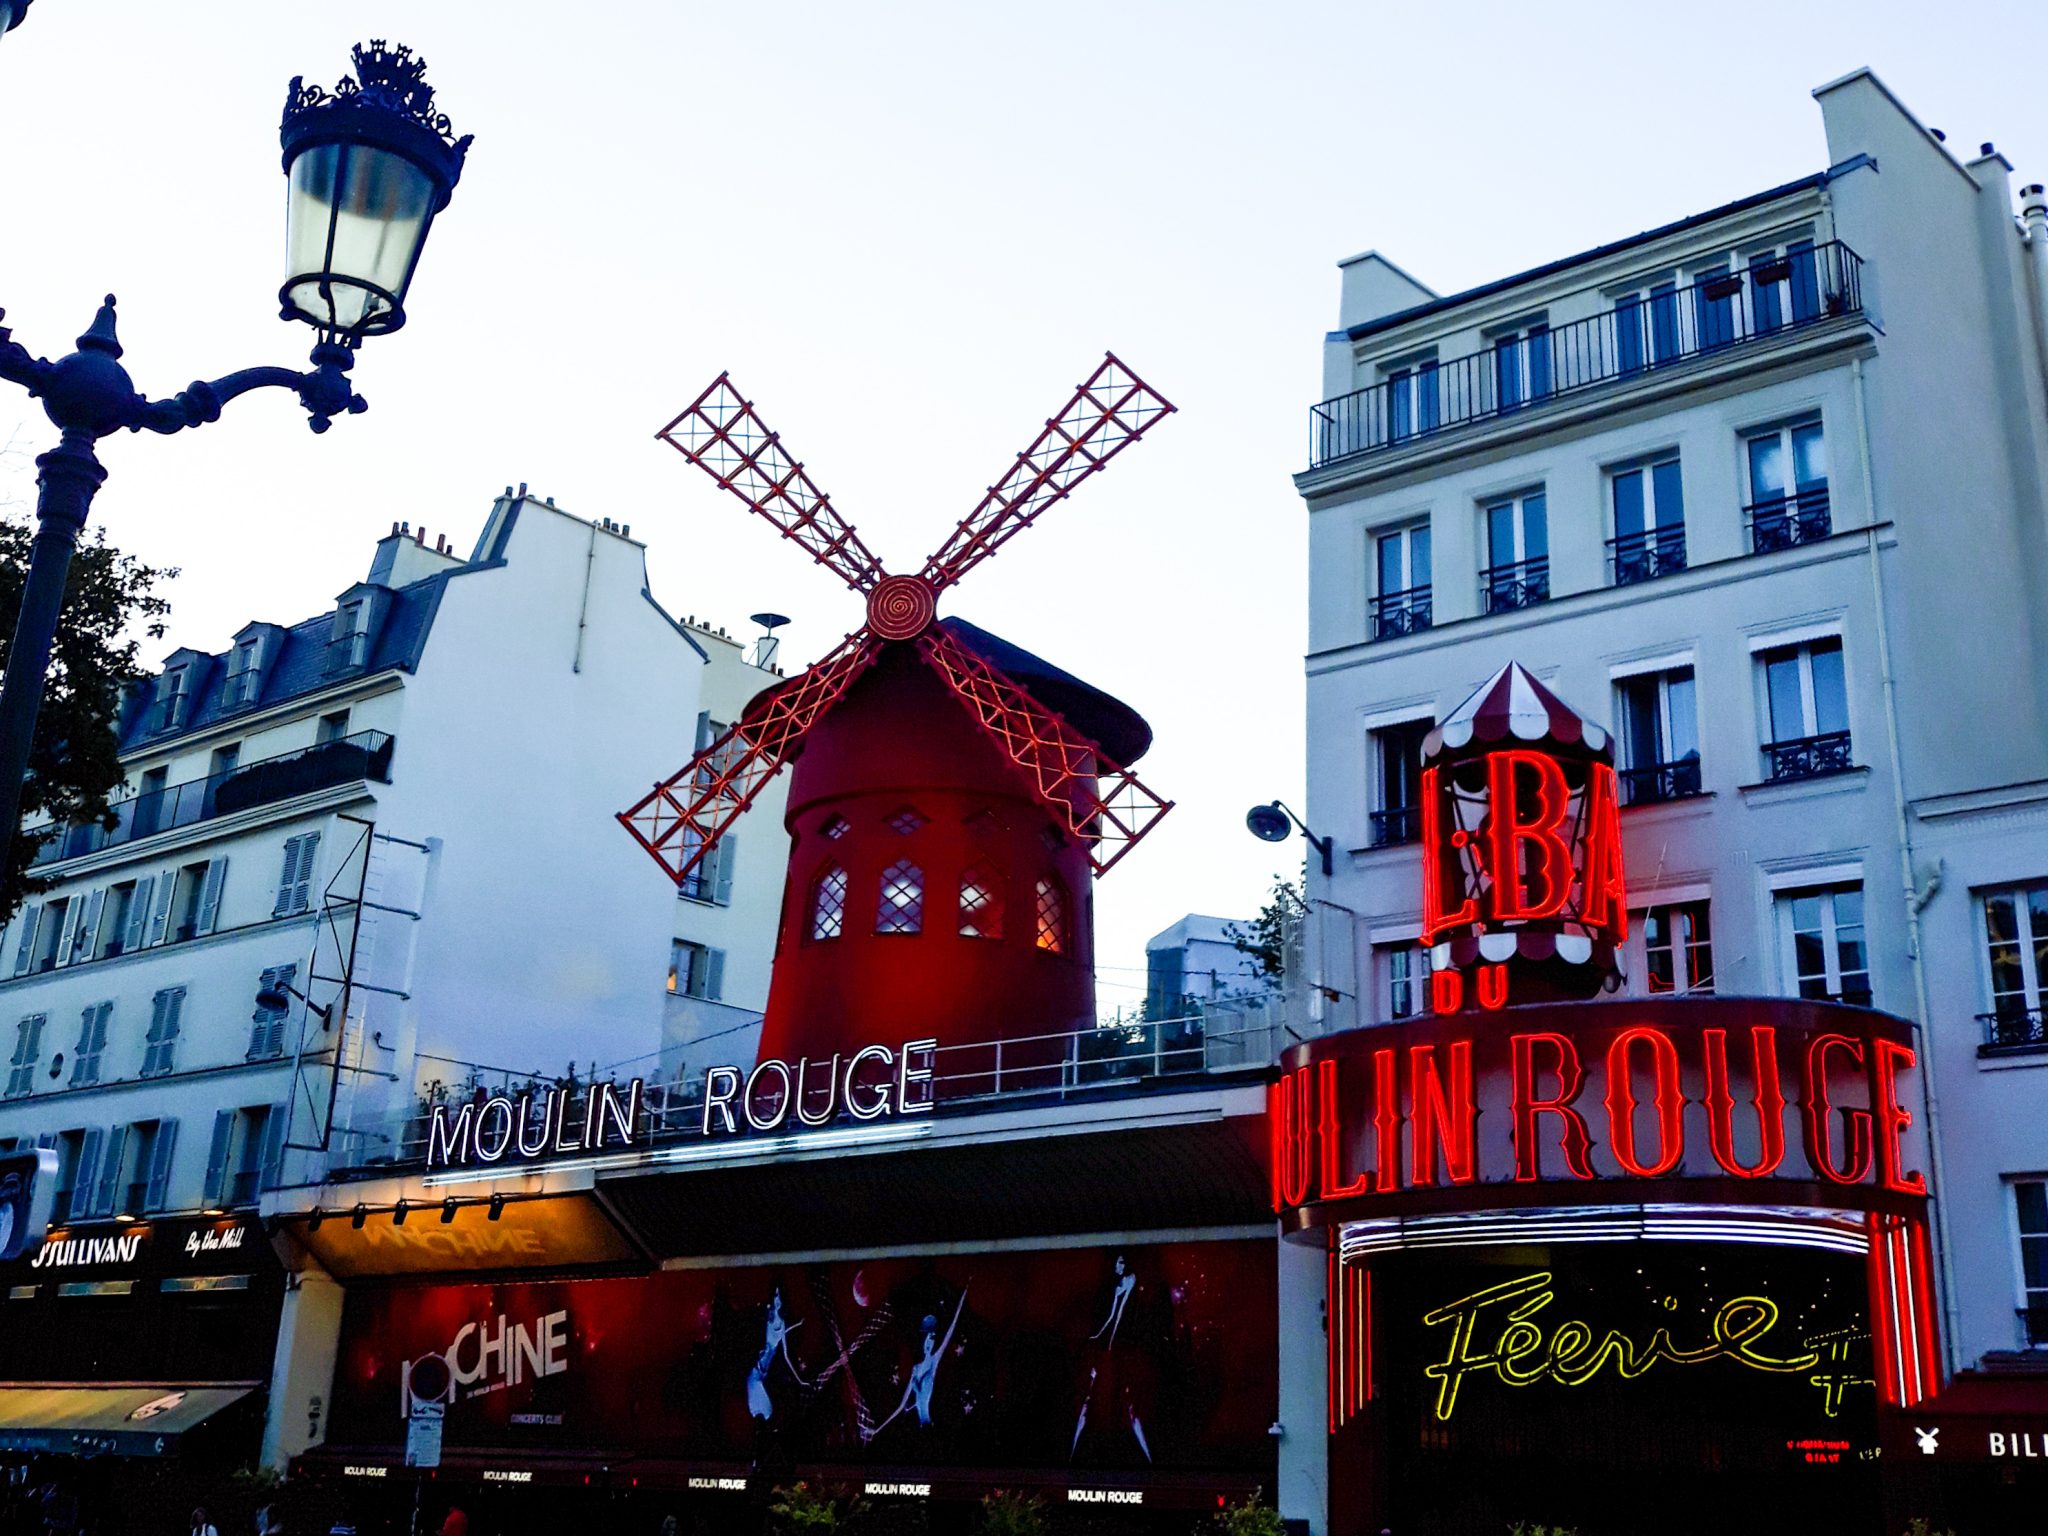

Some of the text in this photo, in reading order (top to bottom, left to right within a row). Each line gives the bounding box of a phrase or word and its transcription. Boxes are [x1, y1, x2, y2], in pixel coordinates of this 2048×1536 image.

[1432, 964, 1508, 1014] DU
[427, 1038, 938, 1165] MOULIN ROUGE
[1510, 1026, 1927, 1195] ROUGE
[201, 1230, 219, 1250] the
[219, 1227, 245, 1249] Mill
[688, 1478, 746, 1490] MOULIN ROUGE
[865, 1484, 931, 1496] MOULIN ROUGE
[1068, 1490, 1143, 1504] MOULIN ROUGE
